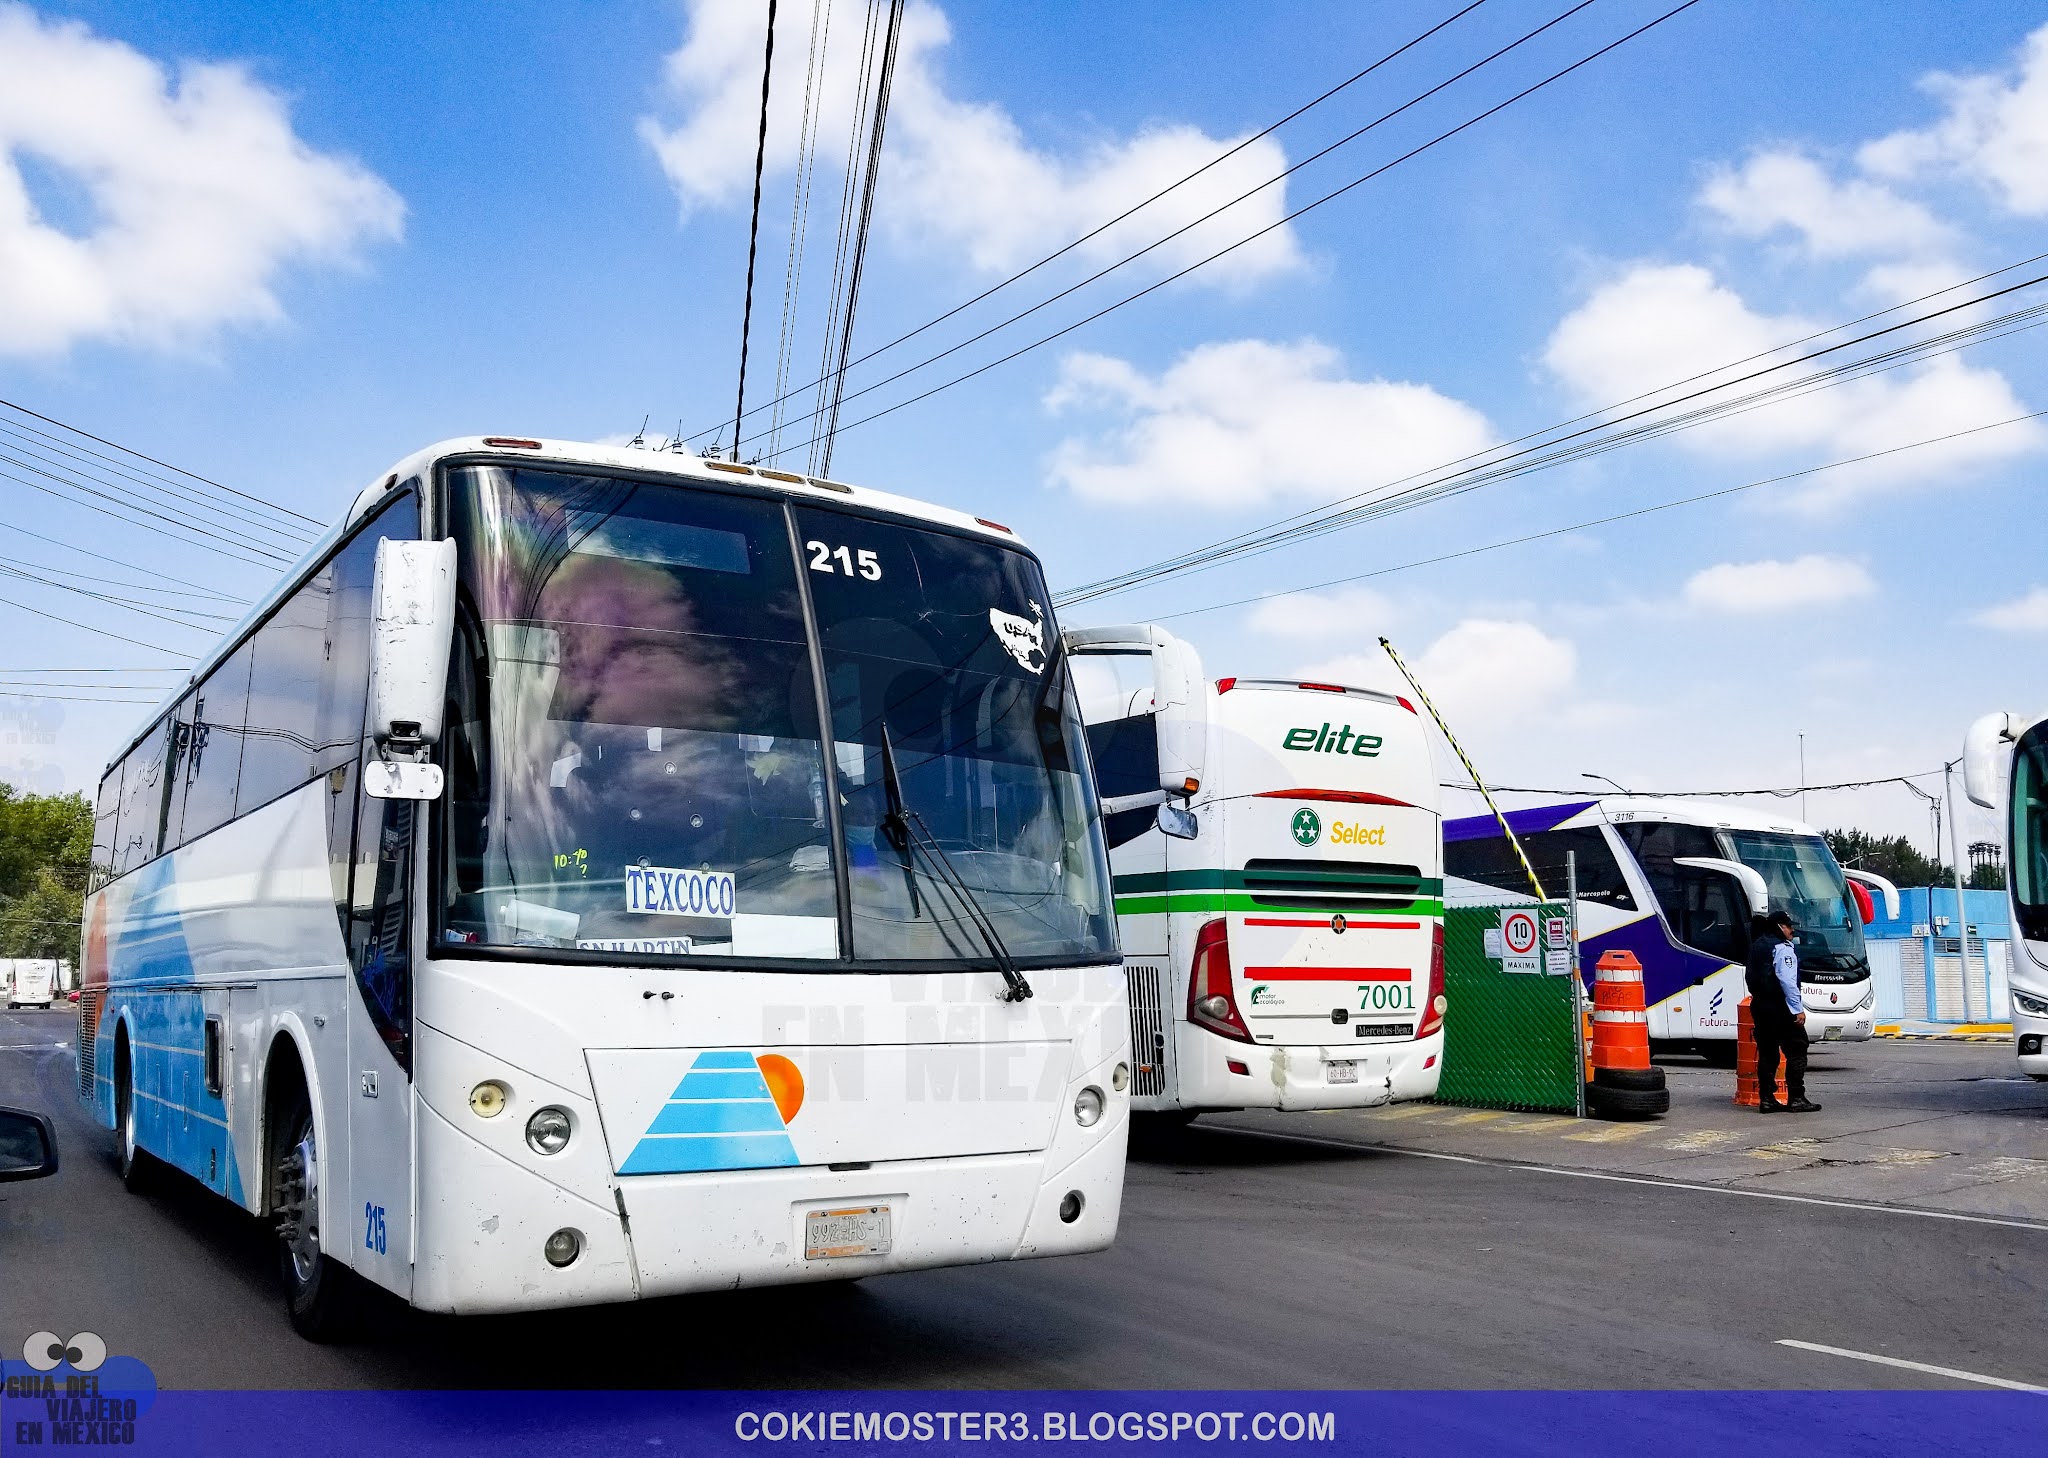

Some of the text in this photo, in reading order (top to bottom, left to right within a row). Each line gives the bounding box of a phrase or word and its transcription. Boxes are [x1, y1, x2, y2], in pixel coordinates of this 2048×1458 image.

[806, 540, 882, 581] 215
[1282, 722, 1383, 758] elite
[1614, 812, 1635, 822] 3116
[1330, 821, 1386, 846] Select
[627, 869, 734, 915] TEXCOCO
[1578, 890, 1611, 899] Marcopolo
[1513, 922, 1528, 939] 10
[1507, 961, 1536, 970] MAXIMA
[1357, 984, 1416, 1010] 7001
[1359, 1025, 1412, 1036] Mercedes-Benz
[1699, 1017, 1729, 1027] Futura
[365, 1201, 387, 1256] 215
